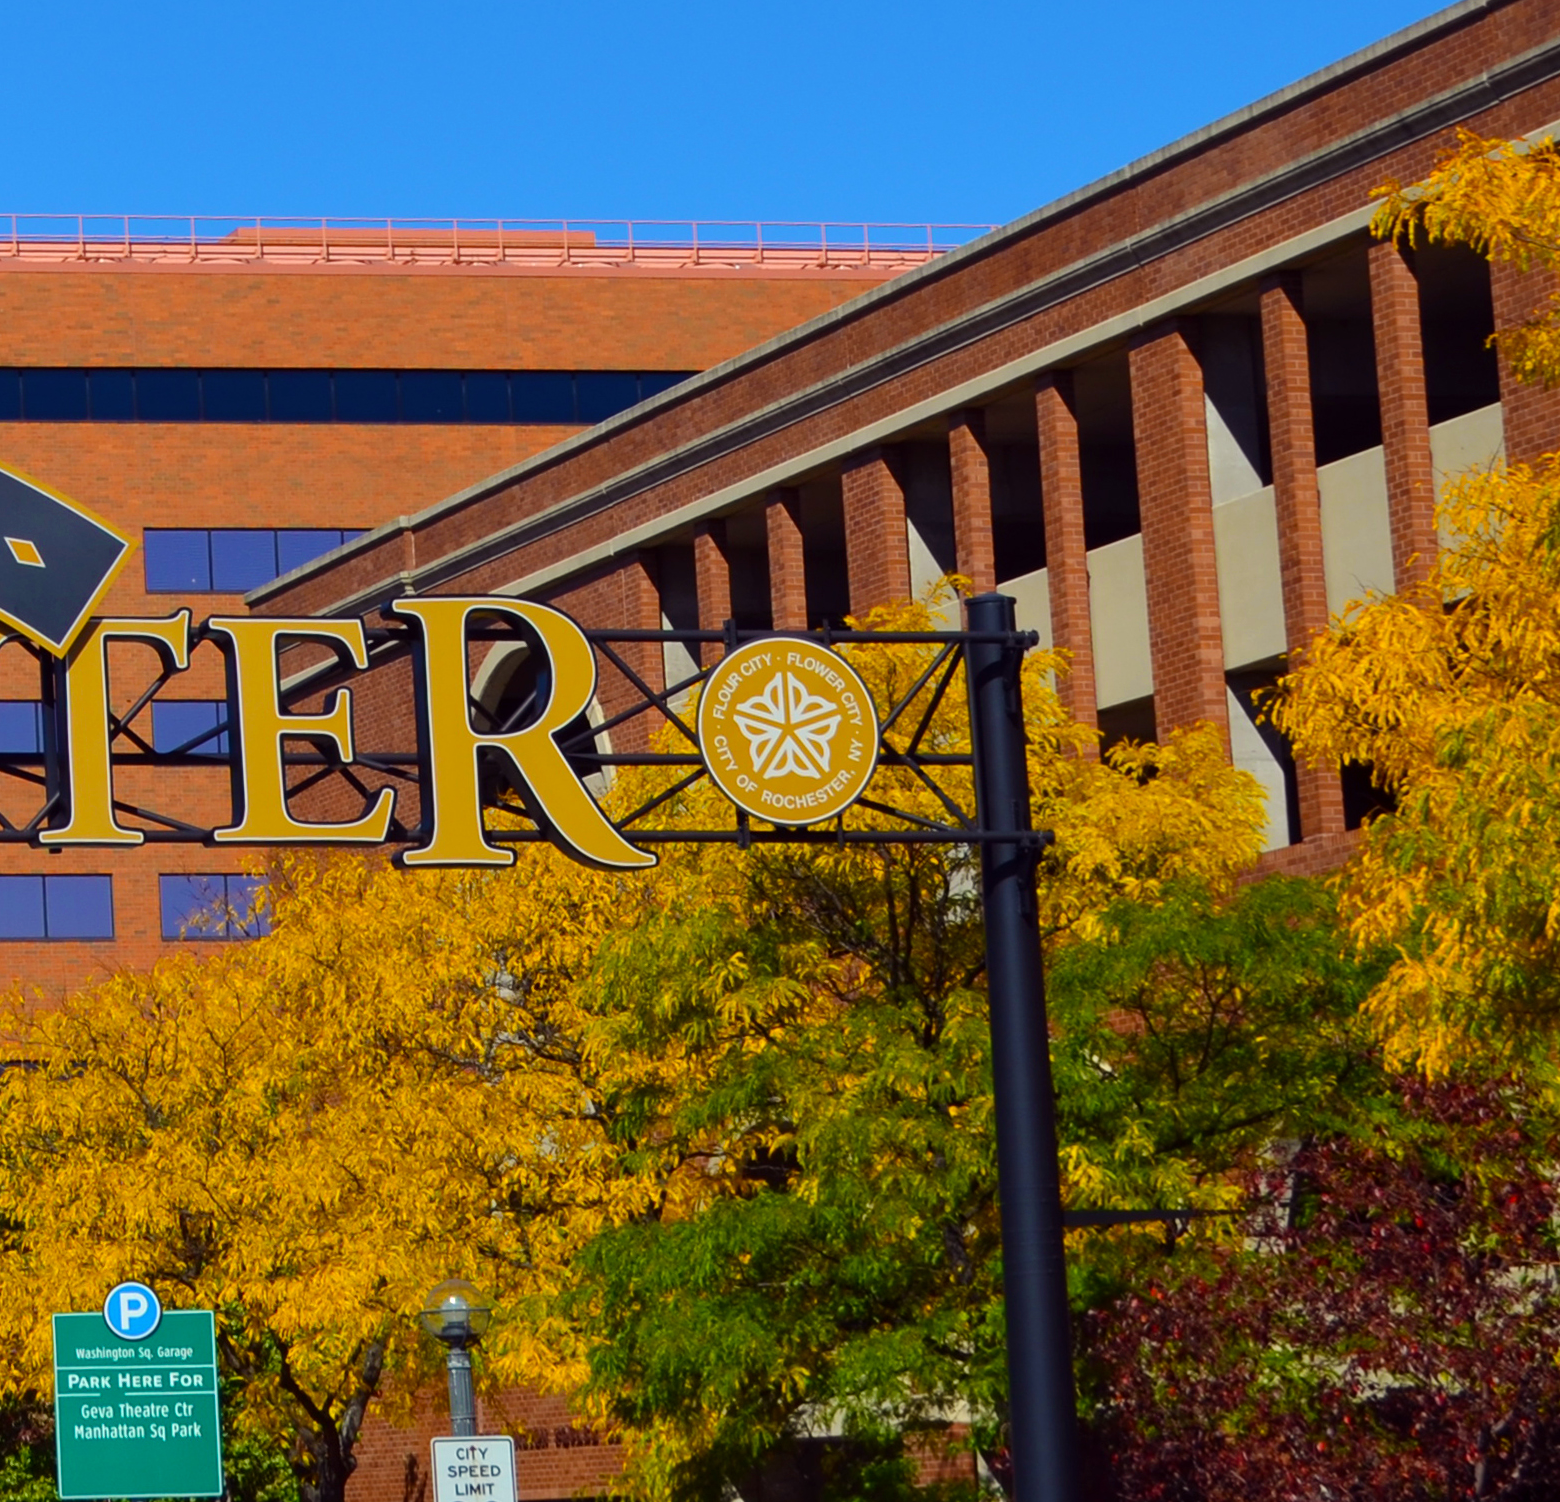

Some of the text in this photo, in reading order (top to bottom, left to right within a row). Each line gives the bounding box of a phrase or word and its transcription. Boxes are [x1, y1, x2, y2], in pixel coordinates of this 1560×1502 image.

[712, 652, 773, 719] FLOUR CITY
[787, 652, 863, 727] FLOWER CITY
[714, 735, 864, 810] CITY OF ROCHESTER, NY
[119, 1292, 149, 1330] P
[75, 1346, 193, 1362] Washington Sq. Garage
[81, 1402, 194, 1419] Geva Theatre Ctr
[74, 1421, 203, 1441] Manhattan Sq Park
[456, 1446, 488, 1460] CITY
[447, 1465, 501, 1478] SPEED
[455, 1483, 495, 1496] LIMIT
